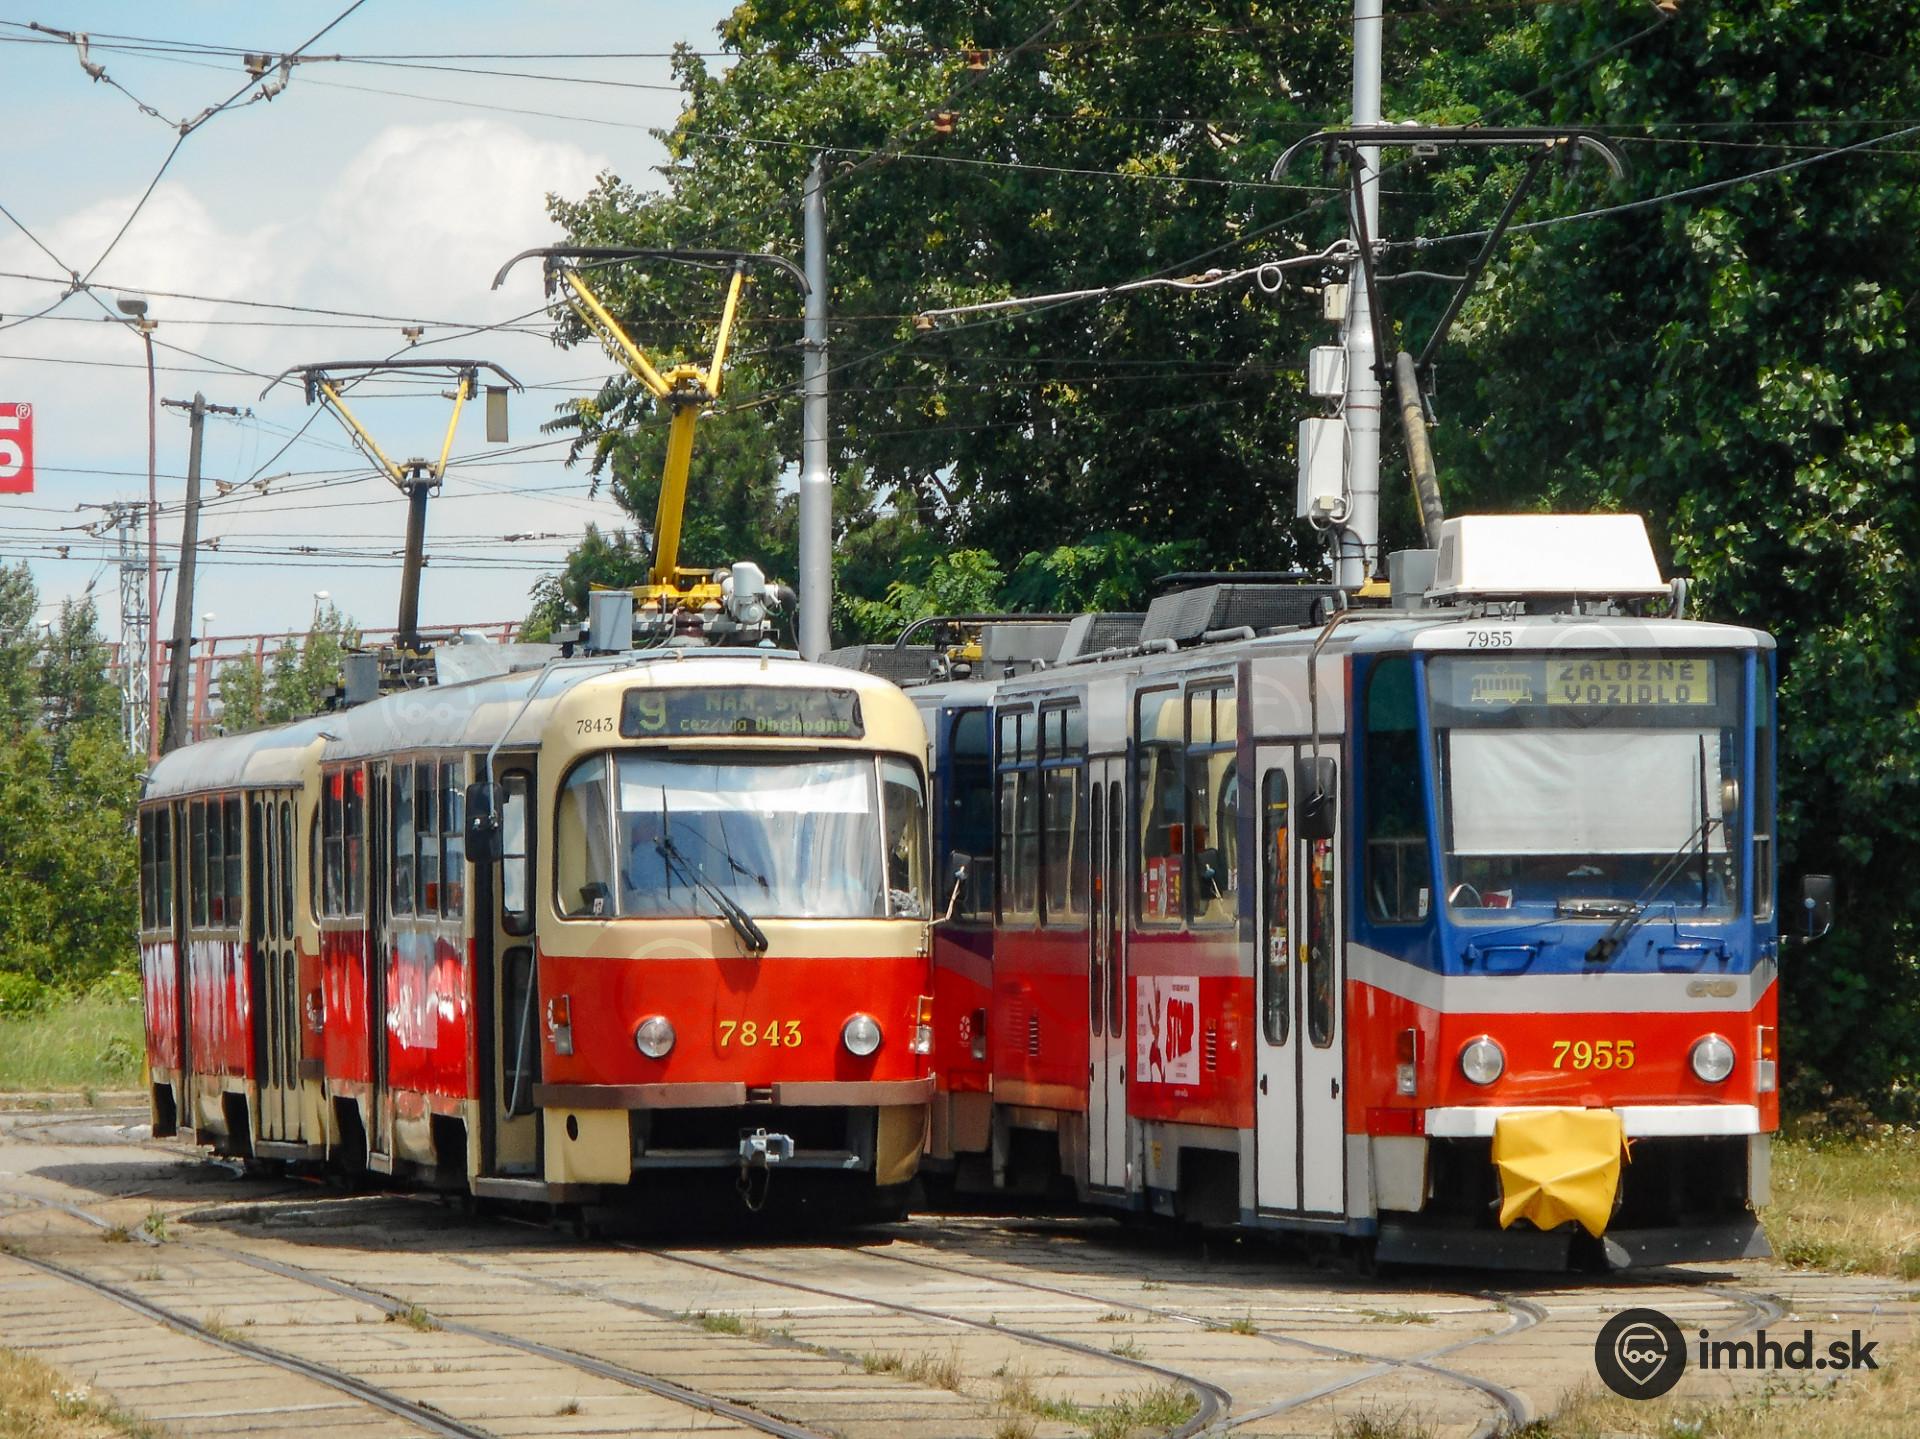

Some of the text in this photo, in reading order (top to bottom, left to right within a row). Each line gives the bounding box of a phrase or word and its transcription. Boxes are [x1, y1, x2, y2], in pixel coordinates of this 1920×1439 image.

[1467, 631, 1513, 648] 7955
[1565, 684, 1691, 704] VOZIDLO
[639, 691, 668, 731] 9
[576, 717, 613, 735] 7843
[720, 1020, 802, 1048] 7843
[1553, 1040, 1635, 1070] 7955
